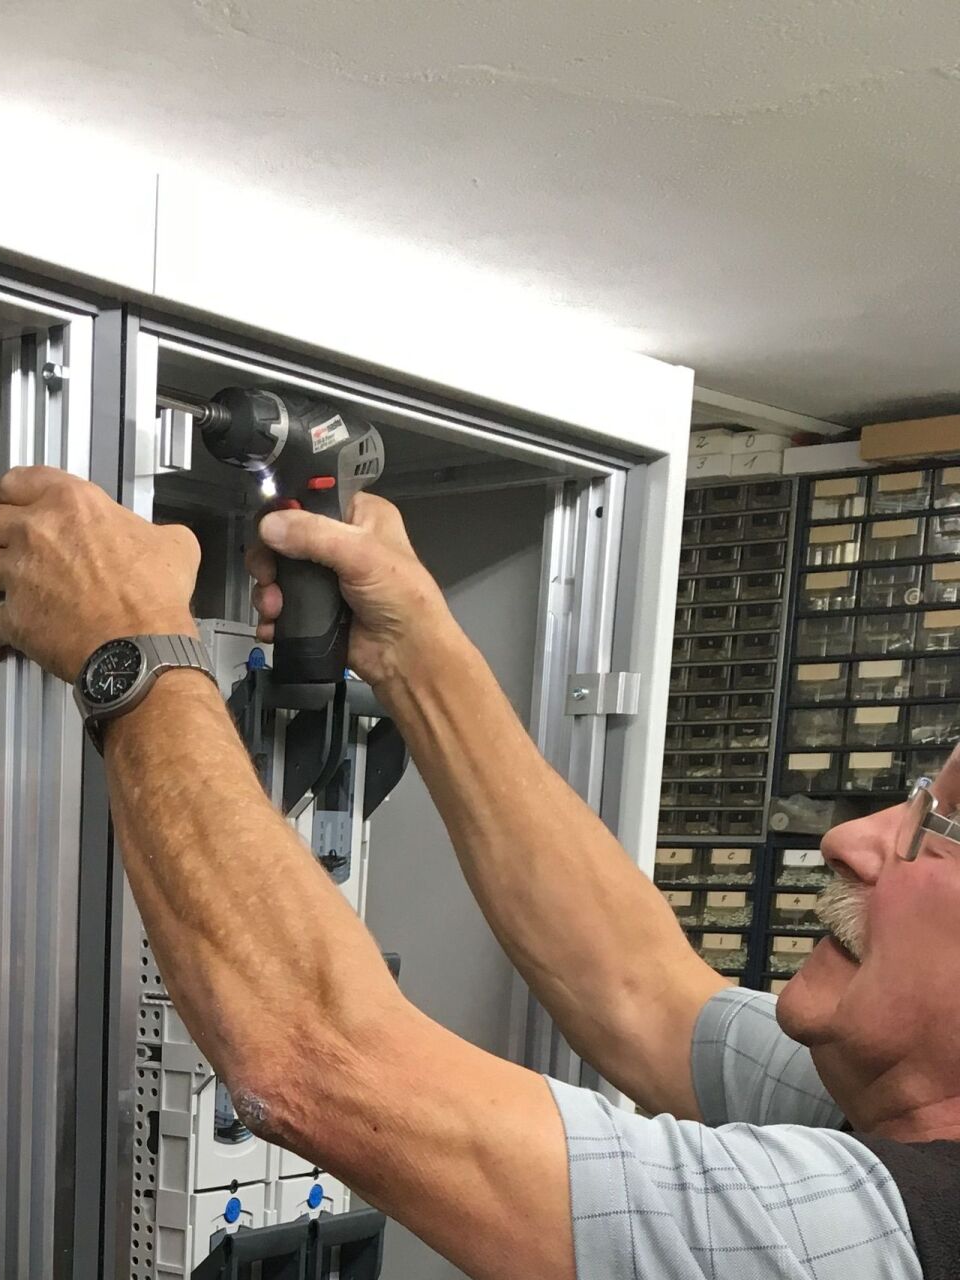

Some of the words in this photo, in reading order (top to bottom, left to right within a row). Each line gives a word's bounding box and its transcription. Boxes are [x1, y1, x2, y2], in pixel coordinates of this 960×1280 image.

[696, 436, 710, 449] 2
[696, 456, 708, 470] 3
[744, 455, 758, 469] 1
[727, 852, 736, 860] C
[800, 852, 808, 862] 1
[721, 894, 728, 903] F
